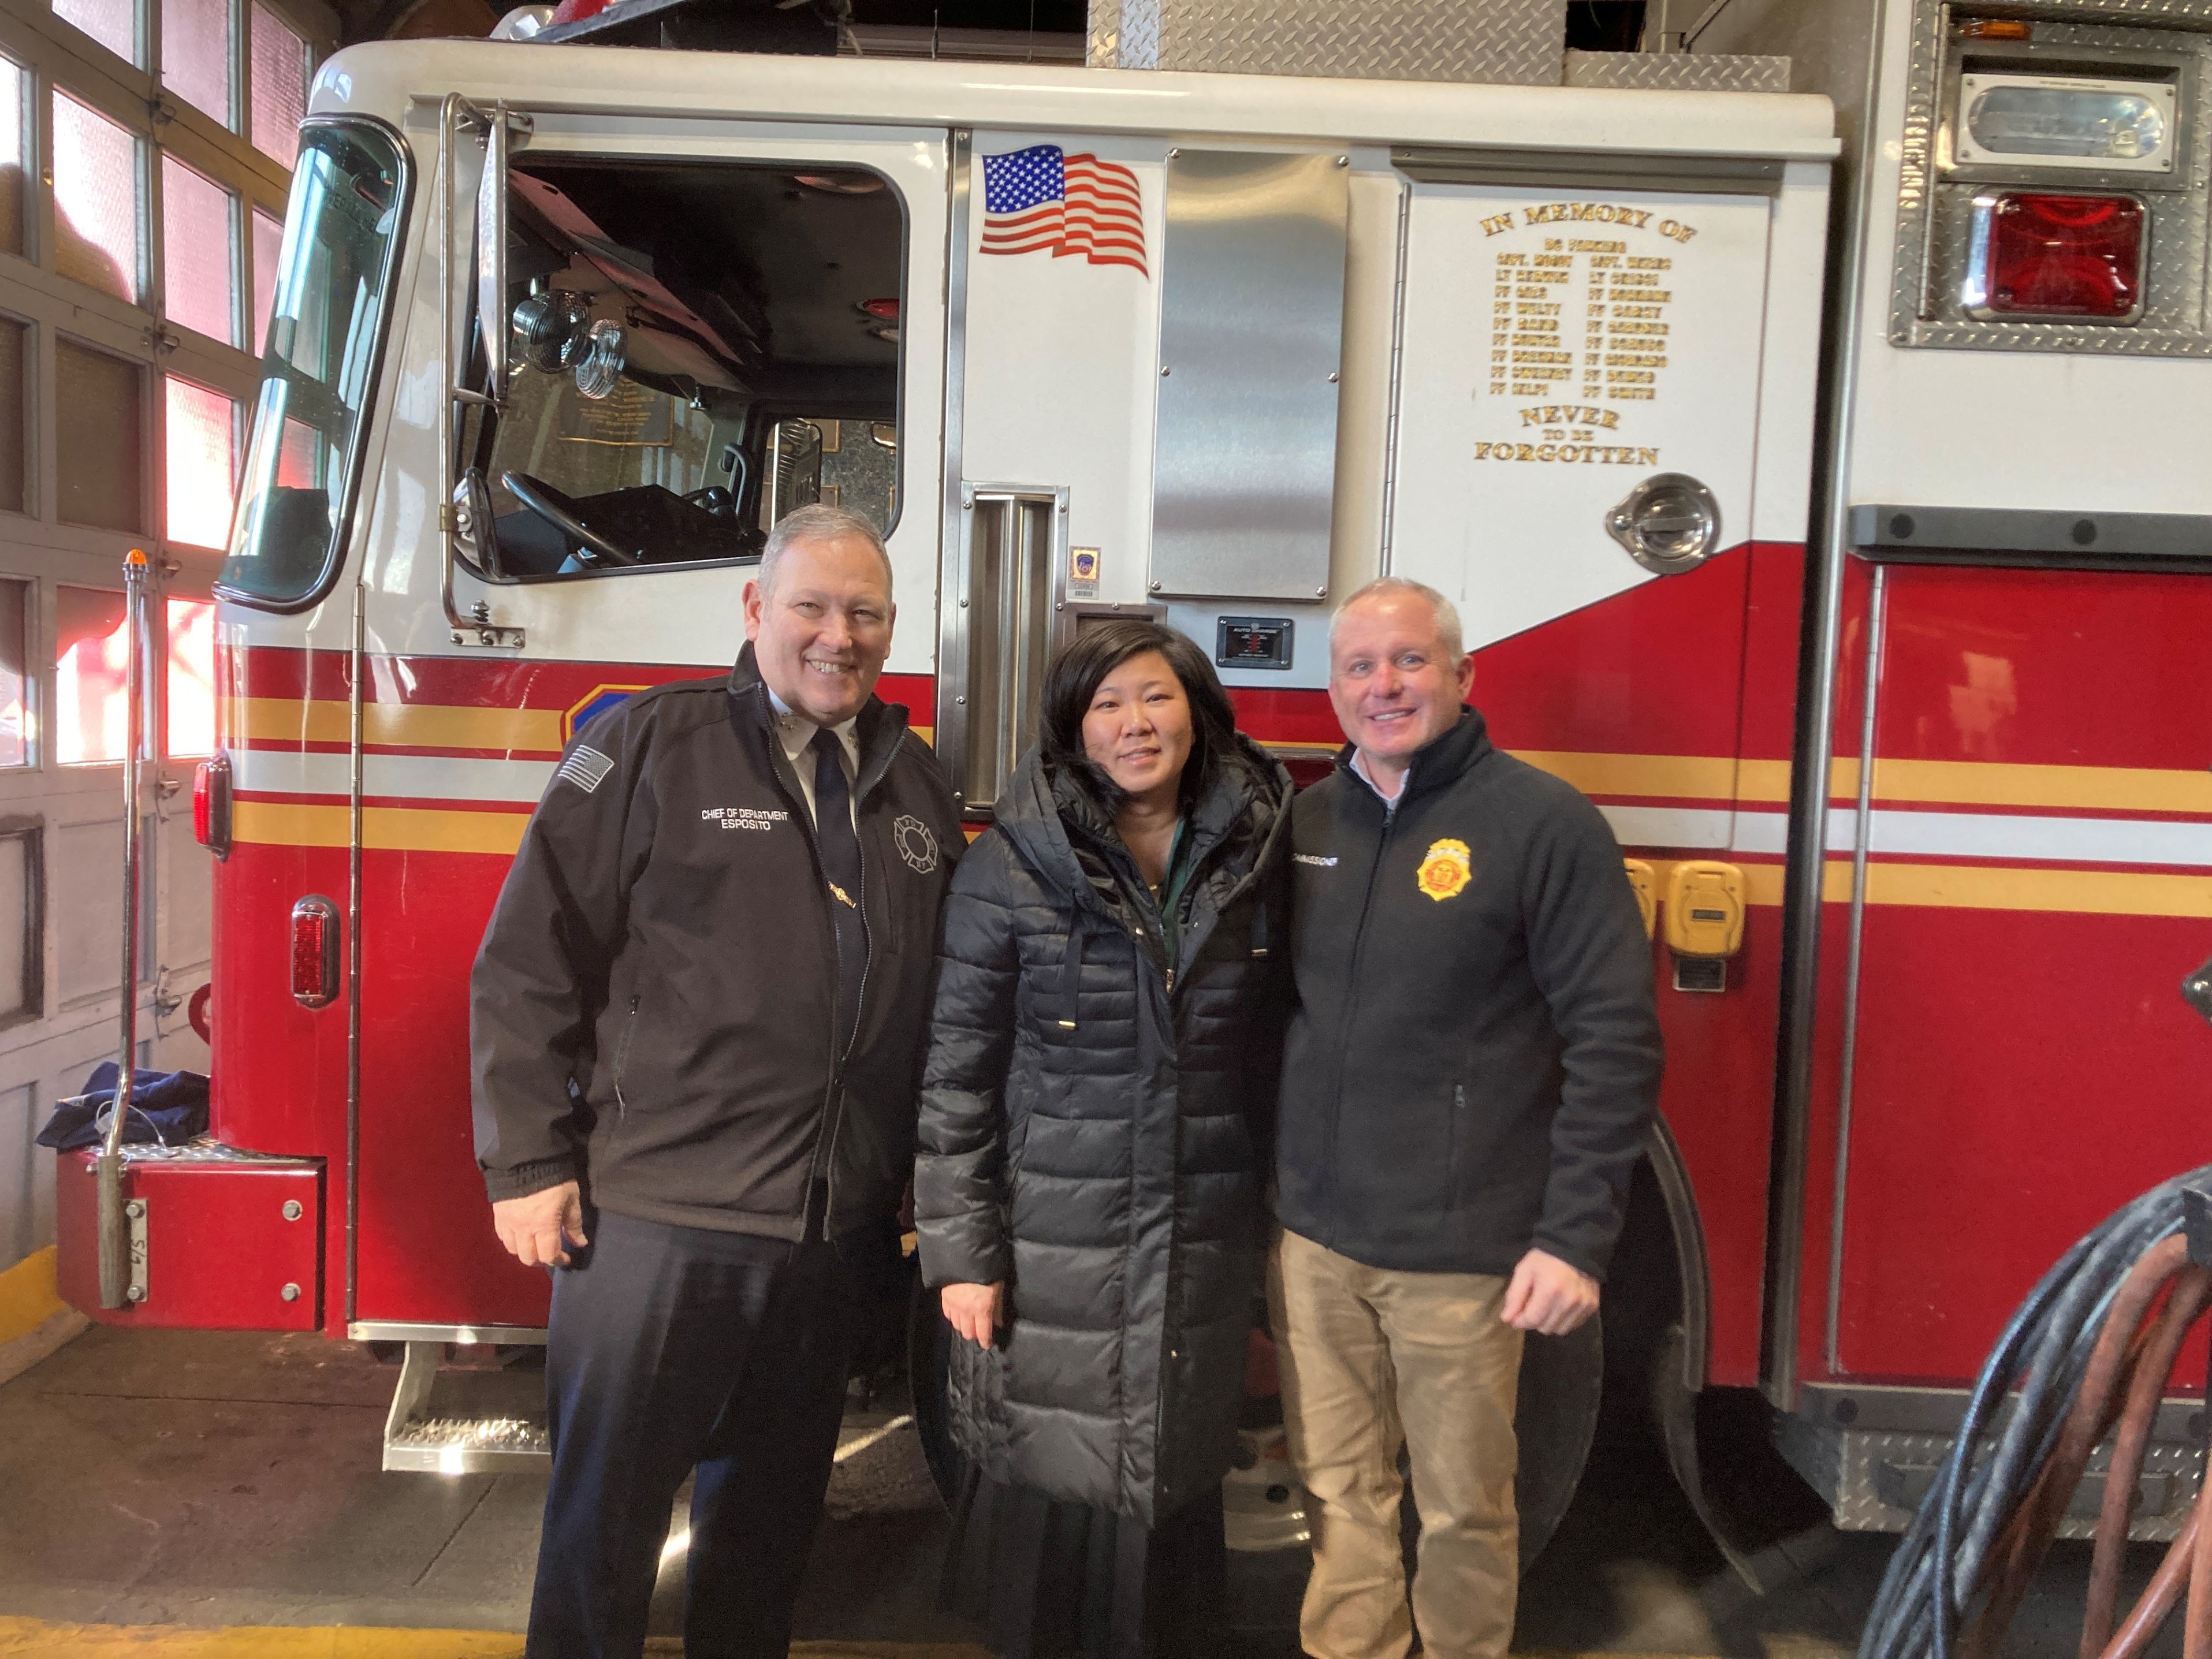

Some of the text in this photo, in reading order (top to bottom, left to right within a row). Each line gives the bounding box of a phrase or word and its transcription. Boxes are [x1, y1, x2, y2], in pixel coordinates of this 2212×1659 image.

[1479, 203, 1699, 244] IN MEMORY OF
[1518, 405, 1621, 430] NEVER
[1543, 428, 1594, 441] TO BE
[1473, 442, 1660, 466] FORGOTTEN
[701, 808, 788, 821] CHIEF OF DEPARTMENT
[721, 818, 771, 830] ESPOSITO
